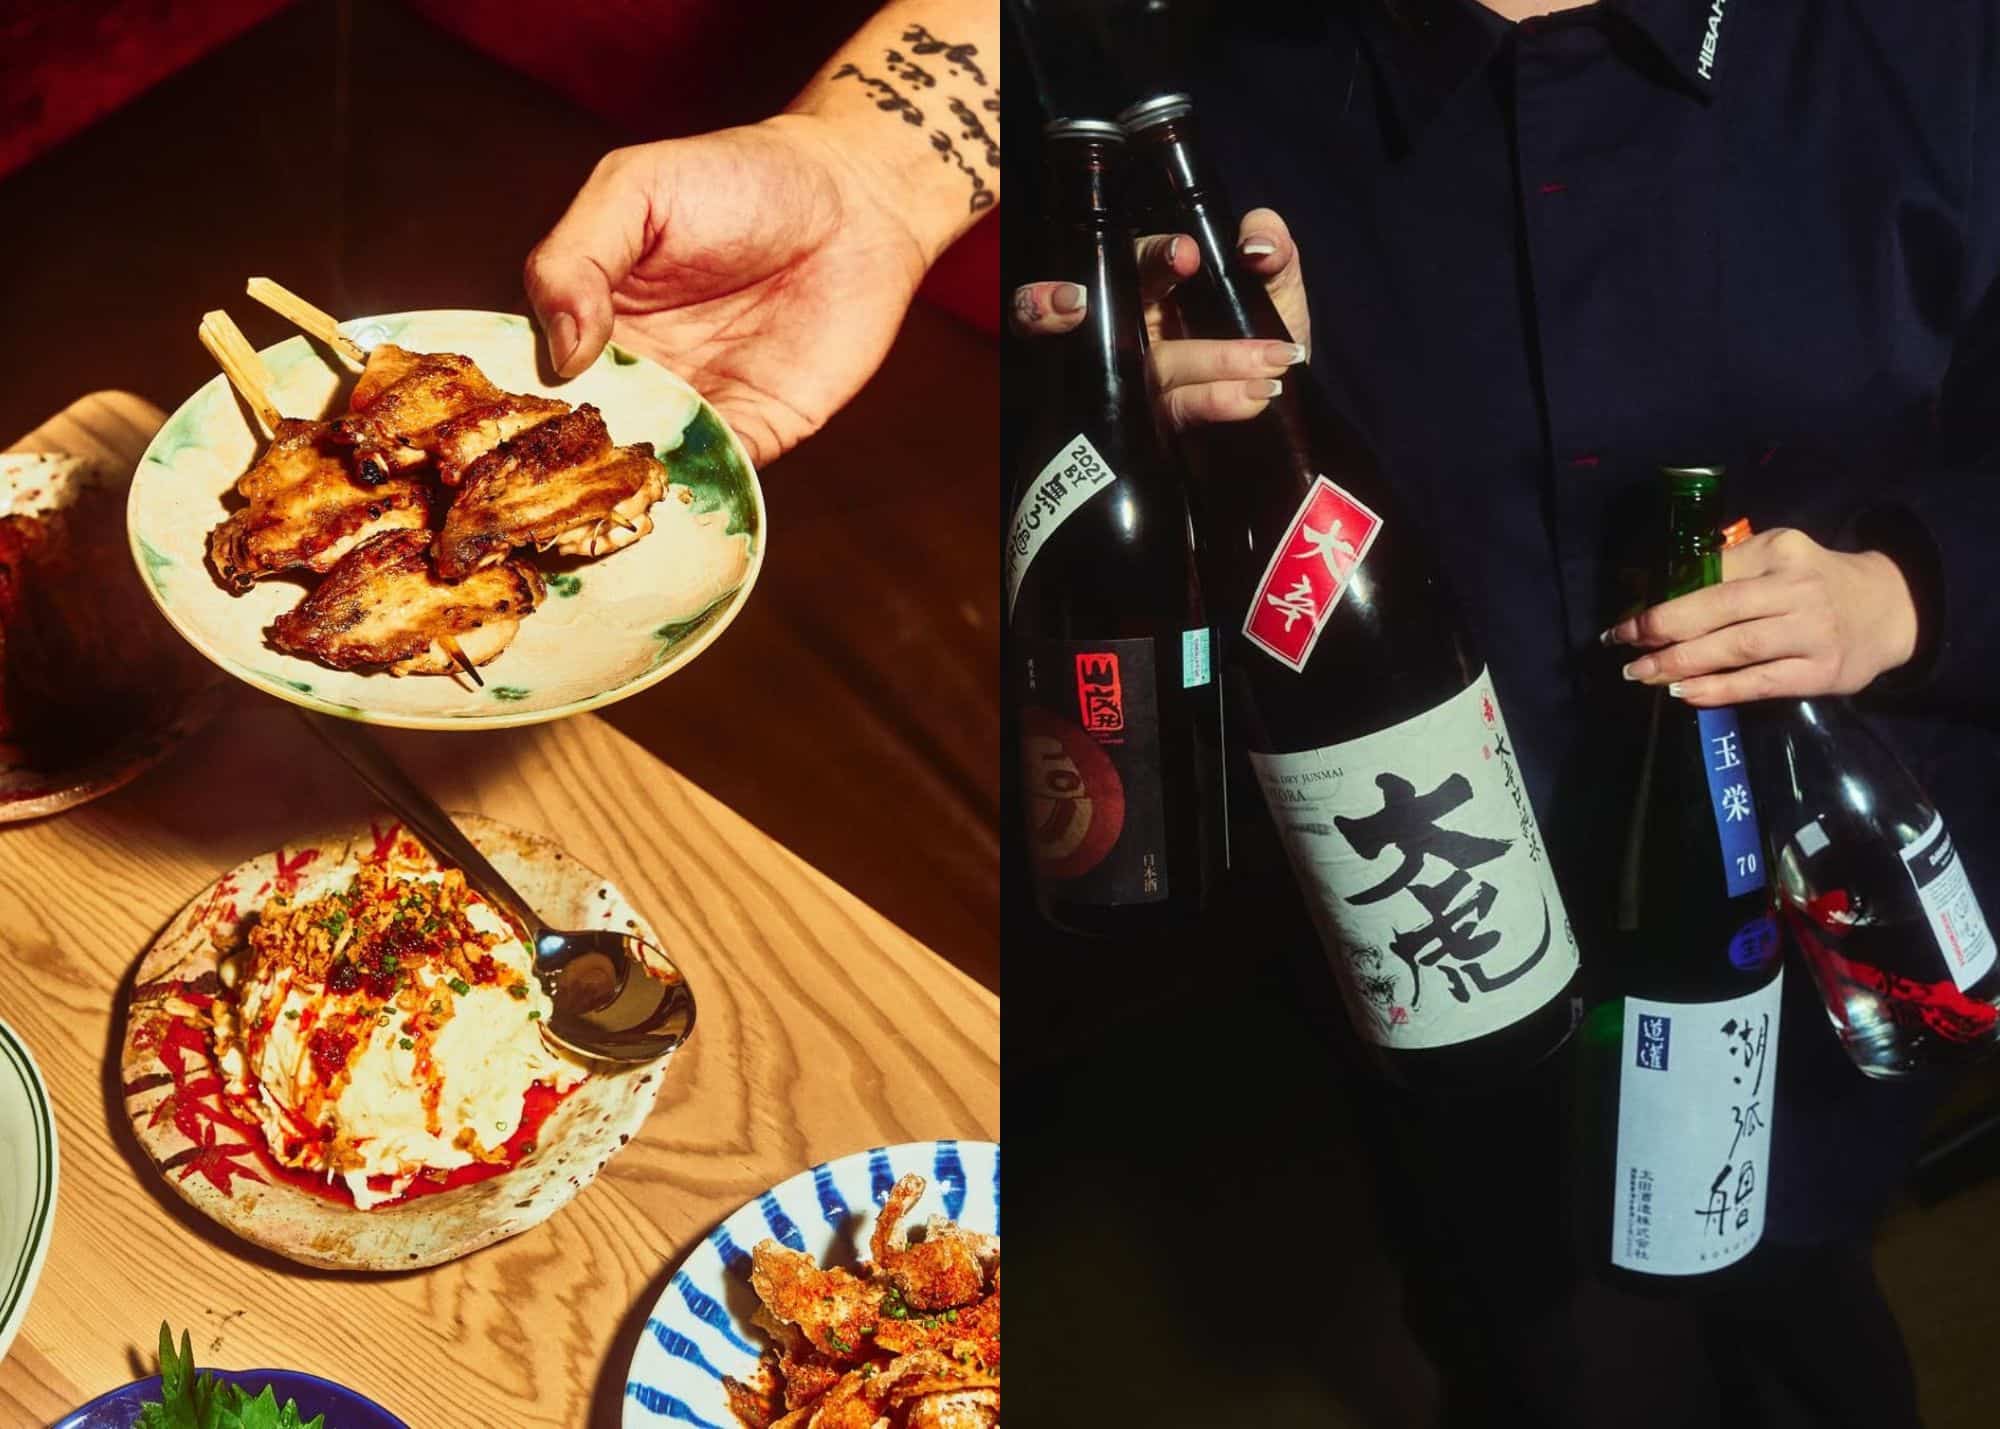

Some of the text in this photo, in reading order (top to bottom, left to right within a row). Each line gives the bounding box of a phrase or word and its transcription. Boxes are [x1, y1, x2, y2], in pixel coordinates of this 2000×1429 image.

[1064, 463, 1087, 487] BY
[1071, 445, 1107, 484] 2021
[1266, 519, 1354, 632] 大辛
[1302, 767, 1344, 785] JUNMAI
[1711, 731, 1758, 877] 玉栄 70
[1333, 772, 1552, 1009] 大虎
